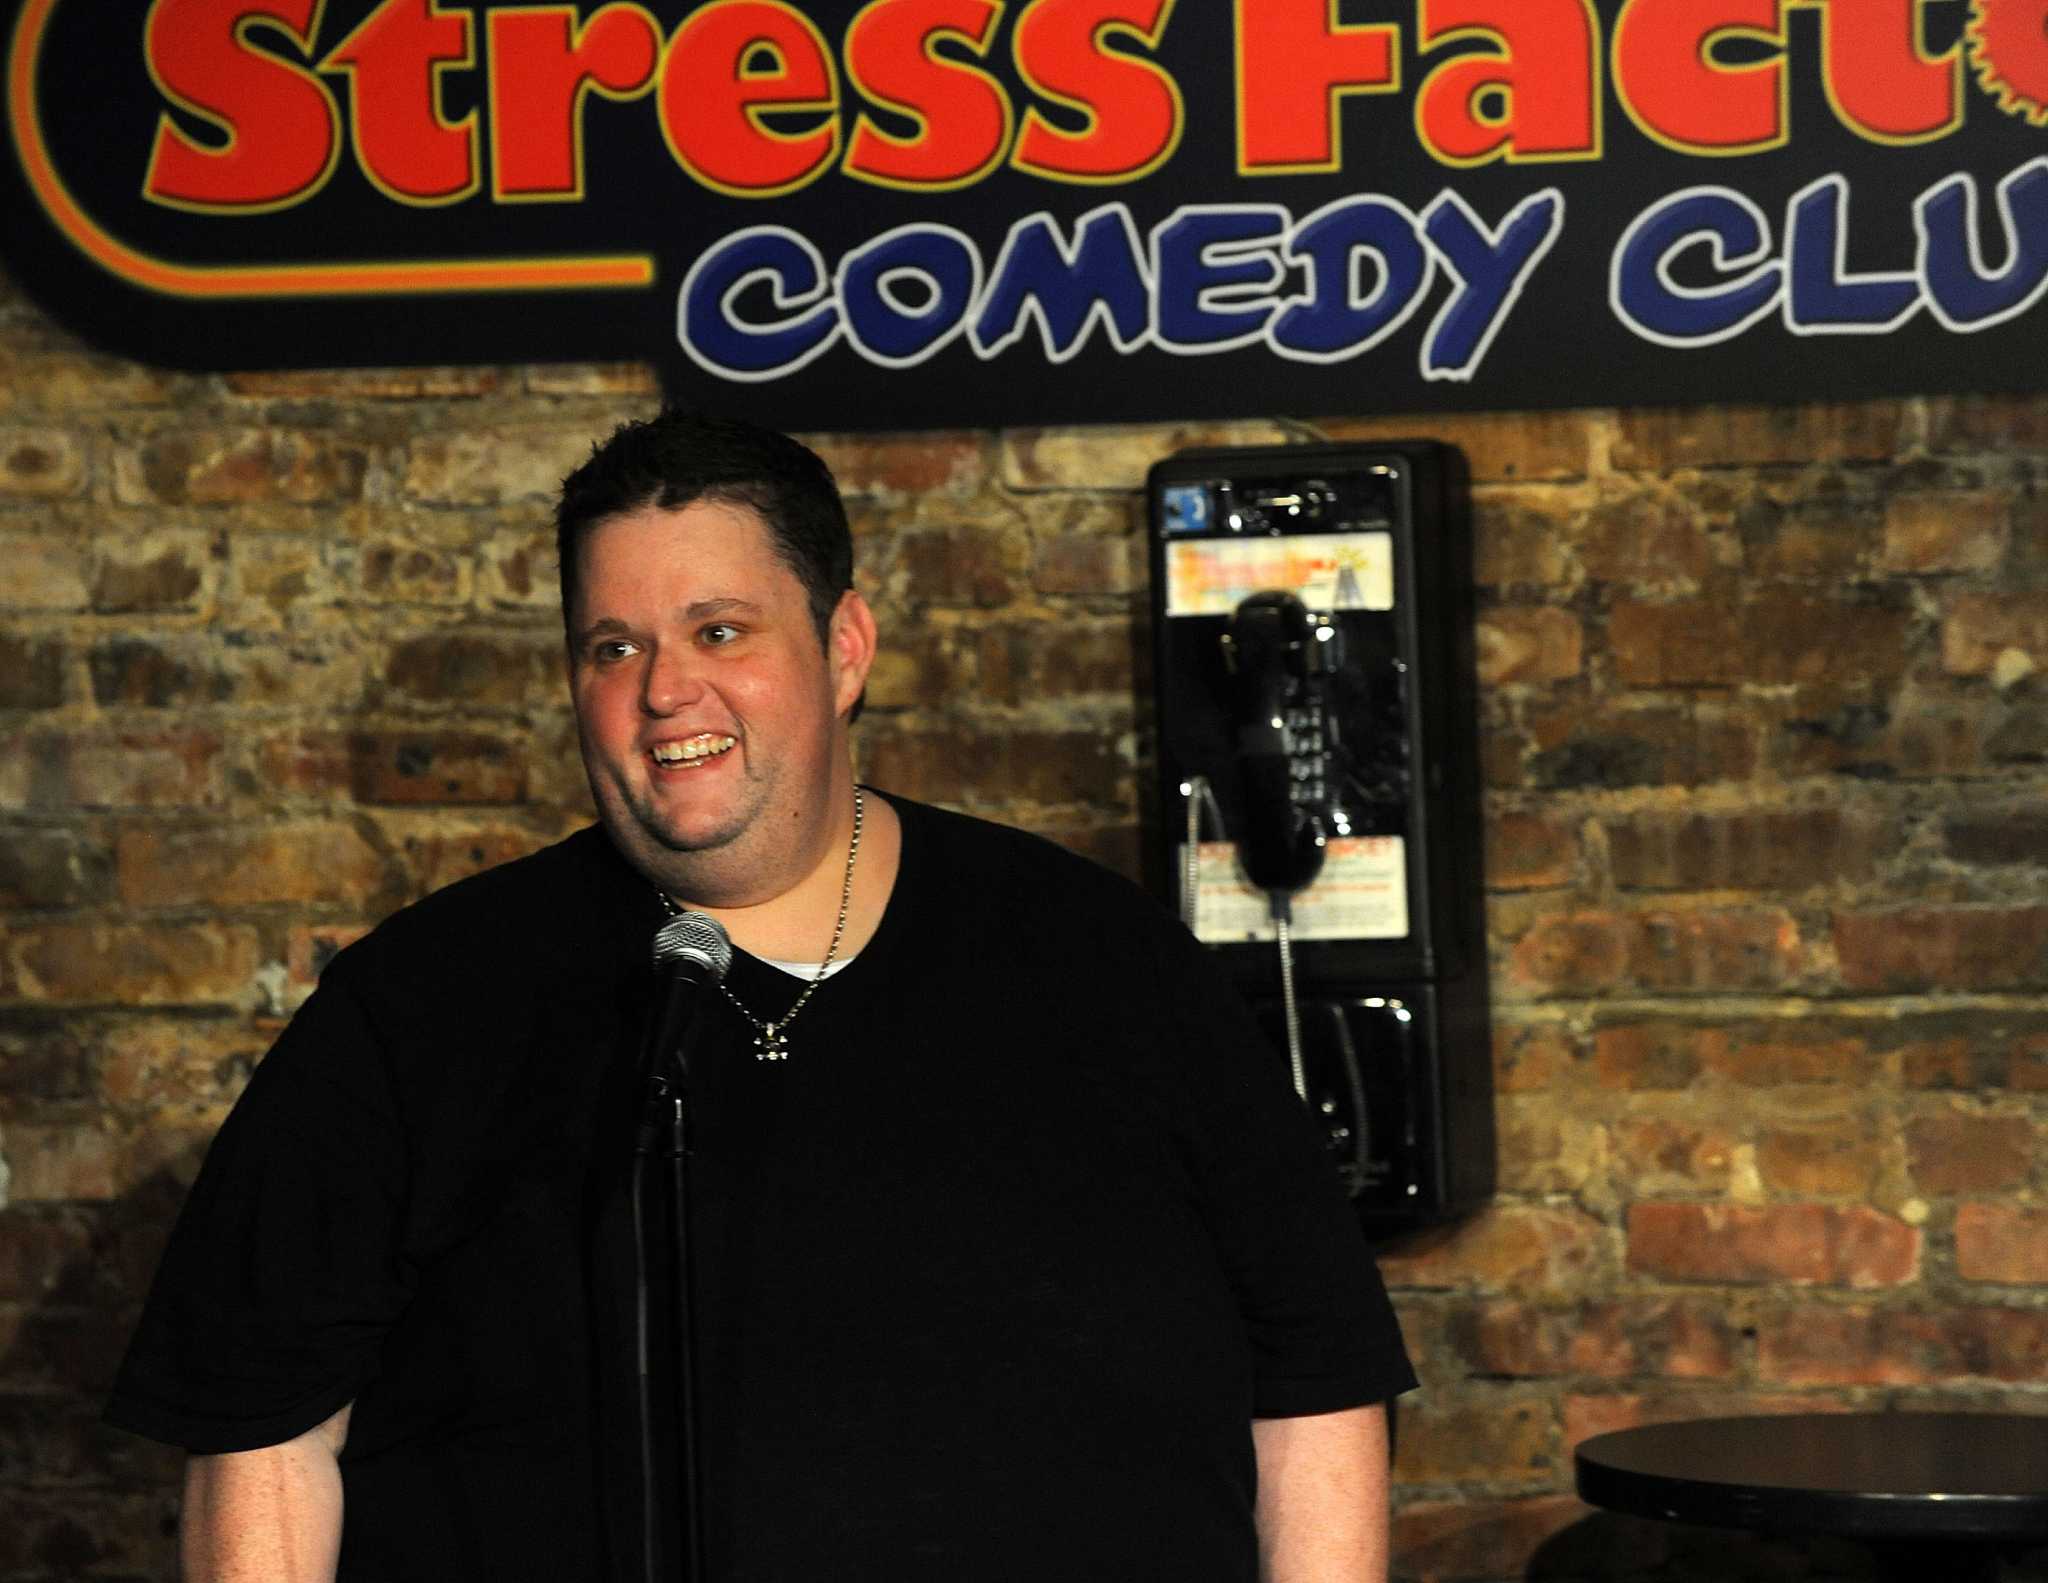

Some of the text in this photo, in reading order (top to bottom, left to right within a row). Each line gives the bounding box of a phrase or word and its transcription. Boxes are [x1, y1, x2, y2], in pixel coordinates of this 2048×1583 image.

[143, 0, 1184, 214] Stress
[676, 155, 2048, 382] COMEDY CLU
